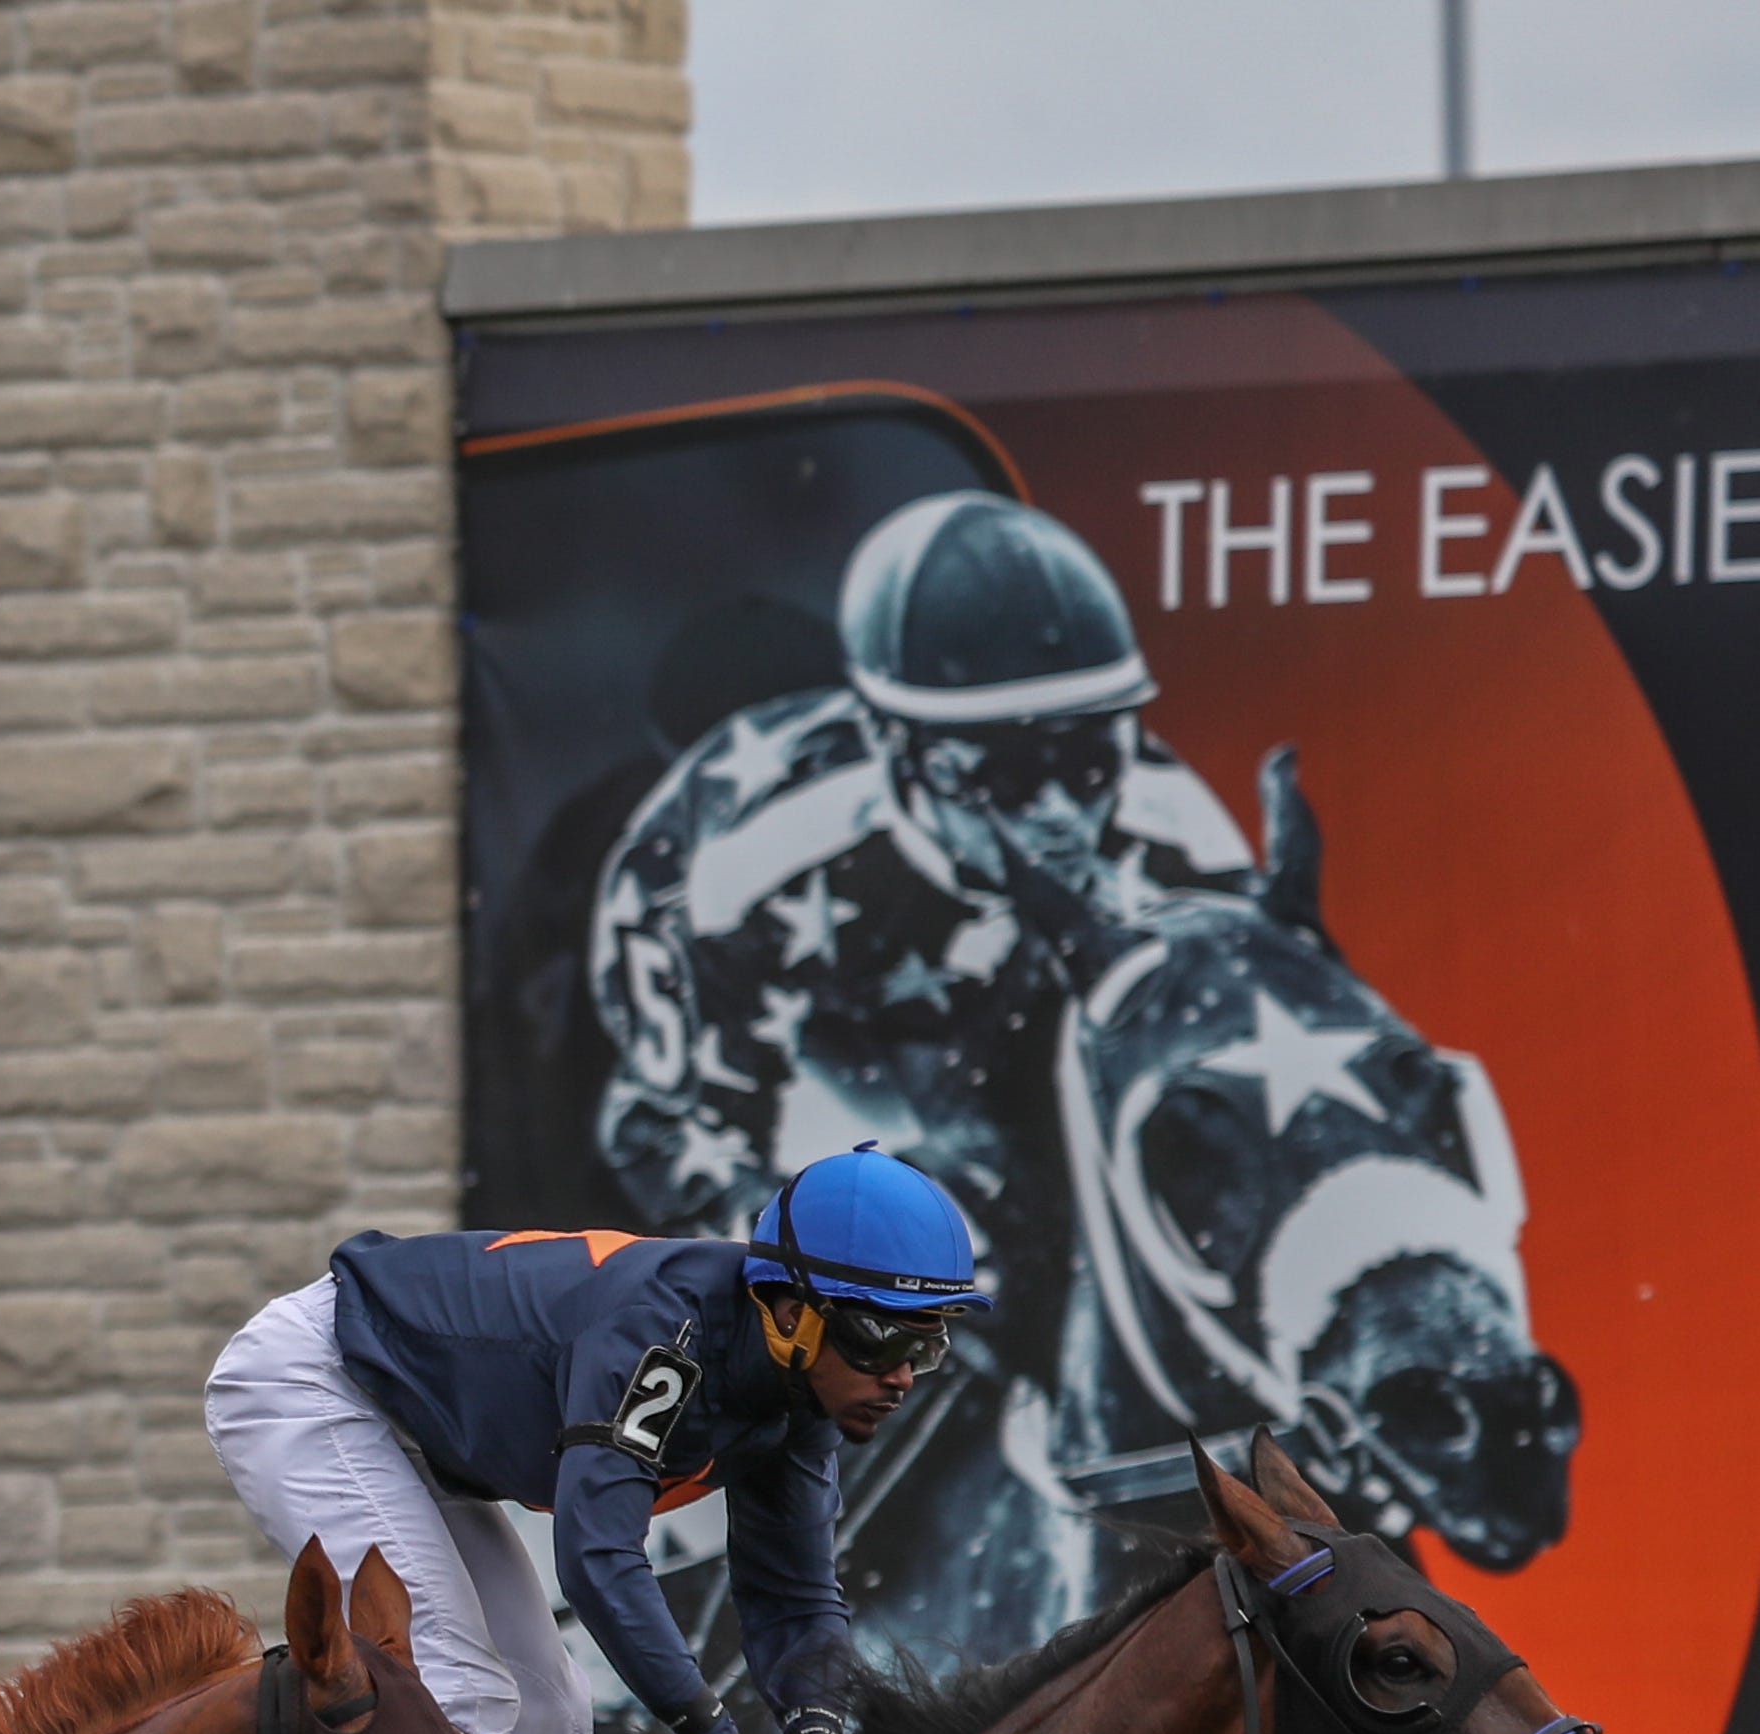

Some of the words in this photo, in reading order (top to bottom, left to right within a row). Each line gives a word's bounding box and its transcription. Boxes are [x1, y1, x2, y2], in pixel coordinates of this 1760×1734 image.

[1140, 470, 1374, 611] THE
[1419, 448, 1760, 600] EASIE
[623, 934, 684, 1089] 5
[622, 1366, 683, 1451] 2
